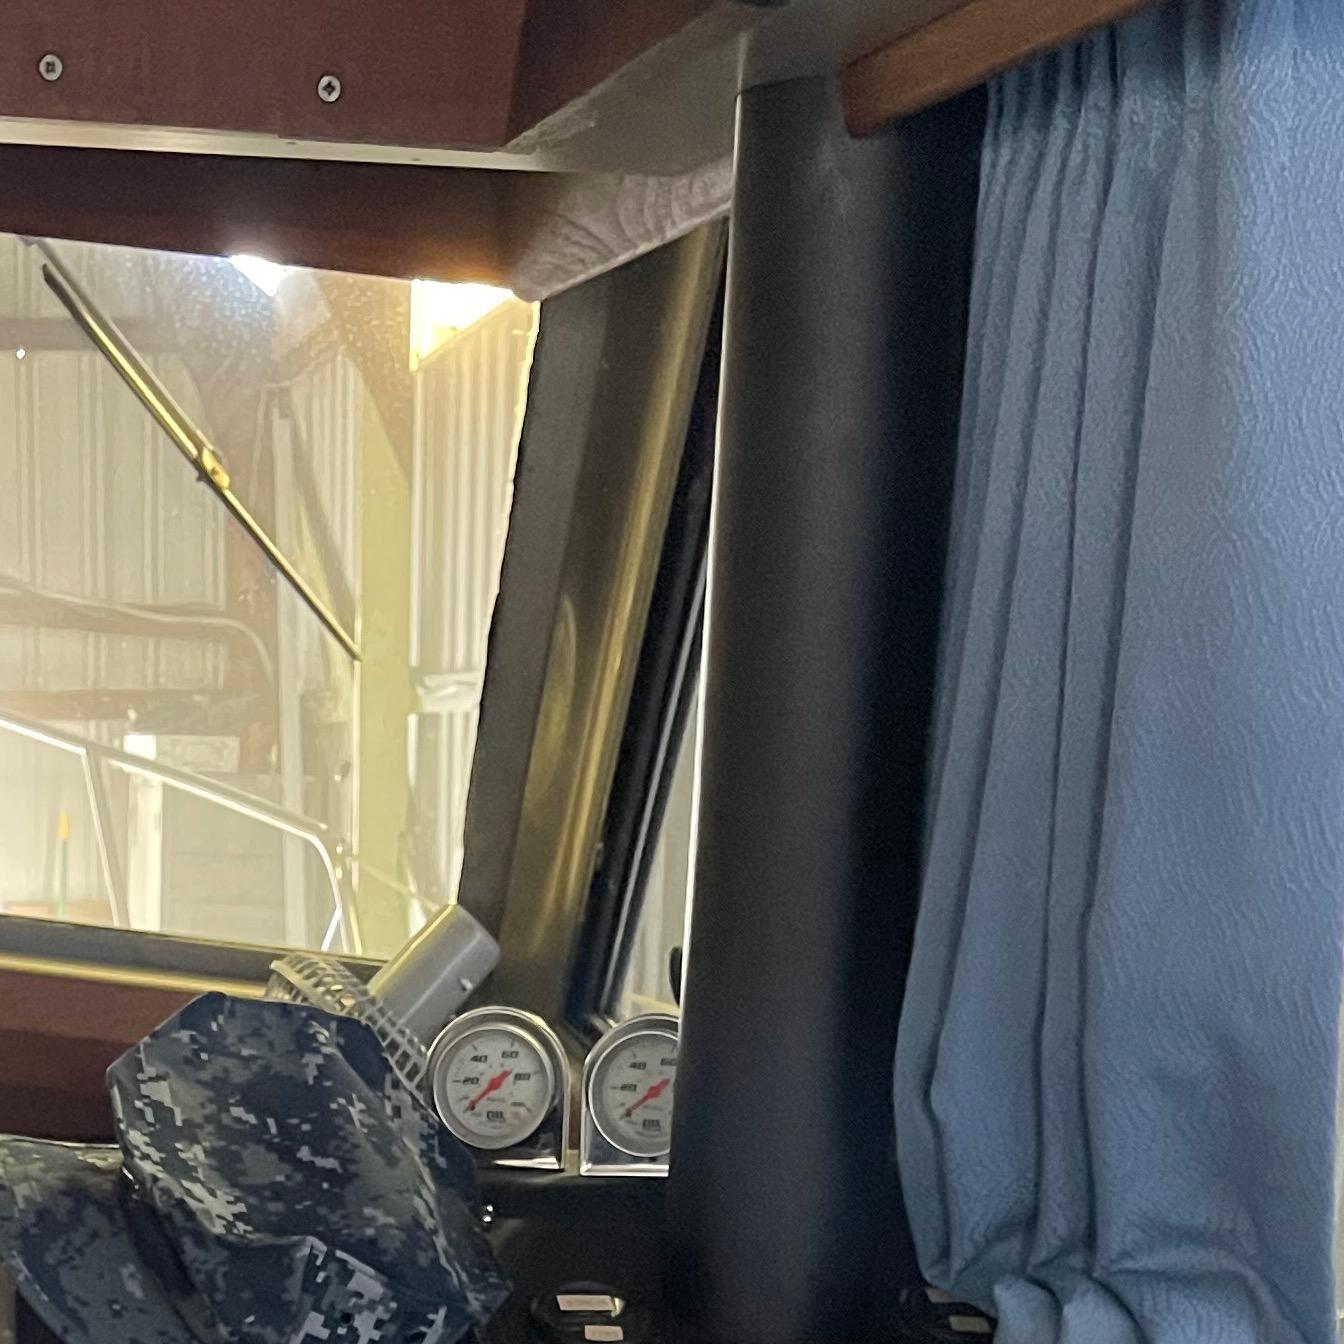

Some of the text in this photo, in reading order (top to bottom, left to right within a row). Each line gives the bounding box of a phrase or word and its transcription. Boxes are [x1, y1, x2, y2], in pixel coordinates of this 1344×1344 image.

[470, 1054, 488, 1064] 40
[501, 1050, 519, 1059] 60
[628, 1061, 647, 1070] 40
[462, 1077, 479, 1085] 20
